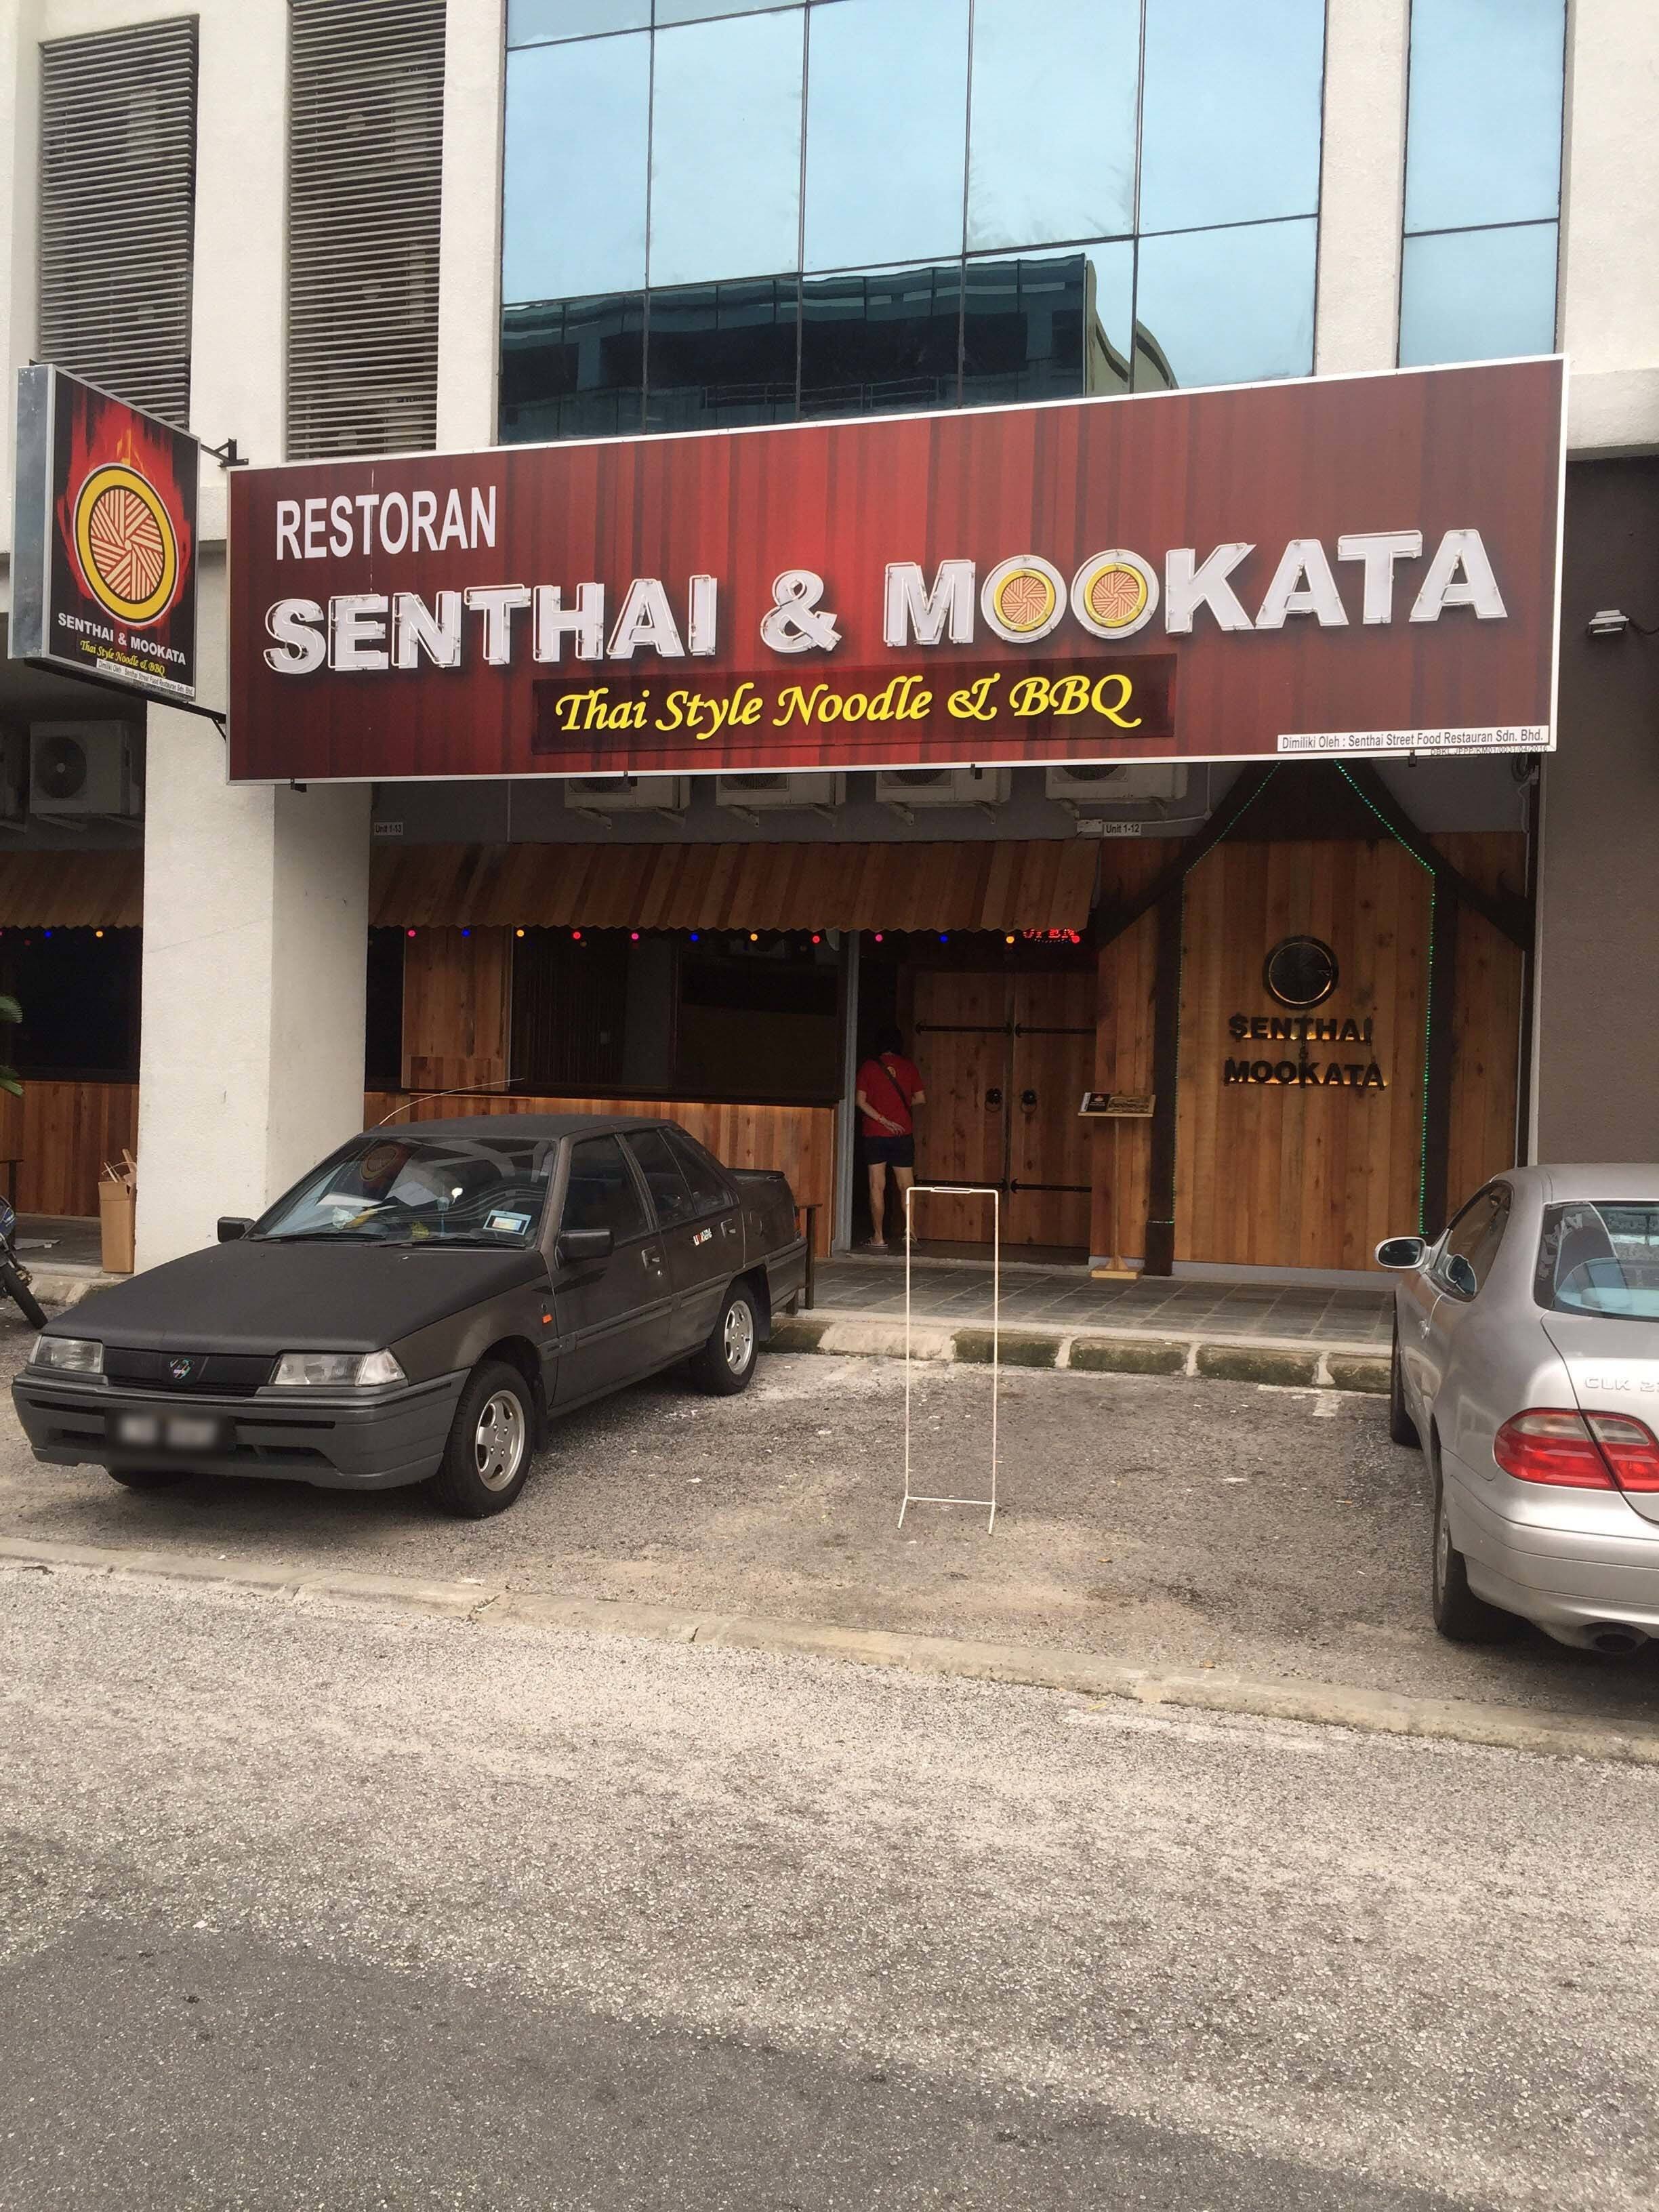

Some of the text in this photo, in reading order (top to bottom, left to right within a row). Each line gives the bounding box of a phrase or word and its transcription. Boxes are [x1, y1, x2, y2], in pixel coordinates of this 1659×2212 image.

[276, 486, 496, 560] RESTORAN
[263, 529, 1509, 674] SENTHAI & MOOKATA
[58, 613, 186, 665] SENTHAI & MOOKATA
[80, 640, 97, 654] Thai
[96, 646, 115, 661] Style
[115, 651, 139, 668] Noodle
[148, 661, 166, 678] BBQ
[556, 672, 1143, 740] Thai Style Noodle & BBQ
[1282, 736, 1316, 749] Dimiliki
[1318, 735, 1340, 747] Oleh
[1348, 734, 1383, 747] Senthai
[1386, 733, 1414, 745] Street
[1417, 732, 1441, 745] Food
[1444, 731, 1493, 744] Restauran
[1495, 729, 1517, 742] Sdn.
[1521, 729, 1544, 741] Bhd.
[1105, 823, 1140, 834] Unit 1-12
[1229, 1015, 1373, 1044] SENTHAI
[1224, 1057, 1386, 1089] MOOKATA
[1584, 1376, 1631, 1391] CLK
